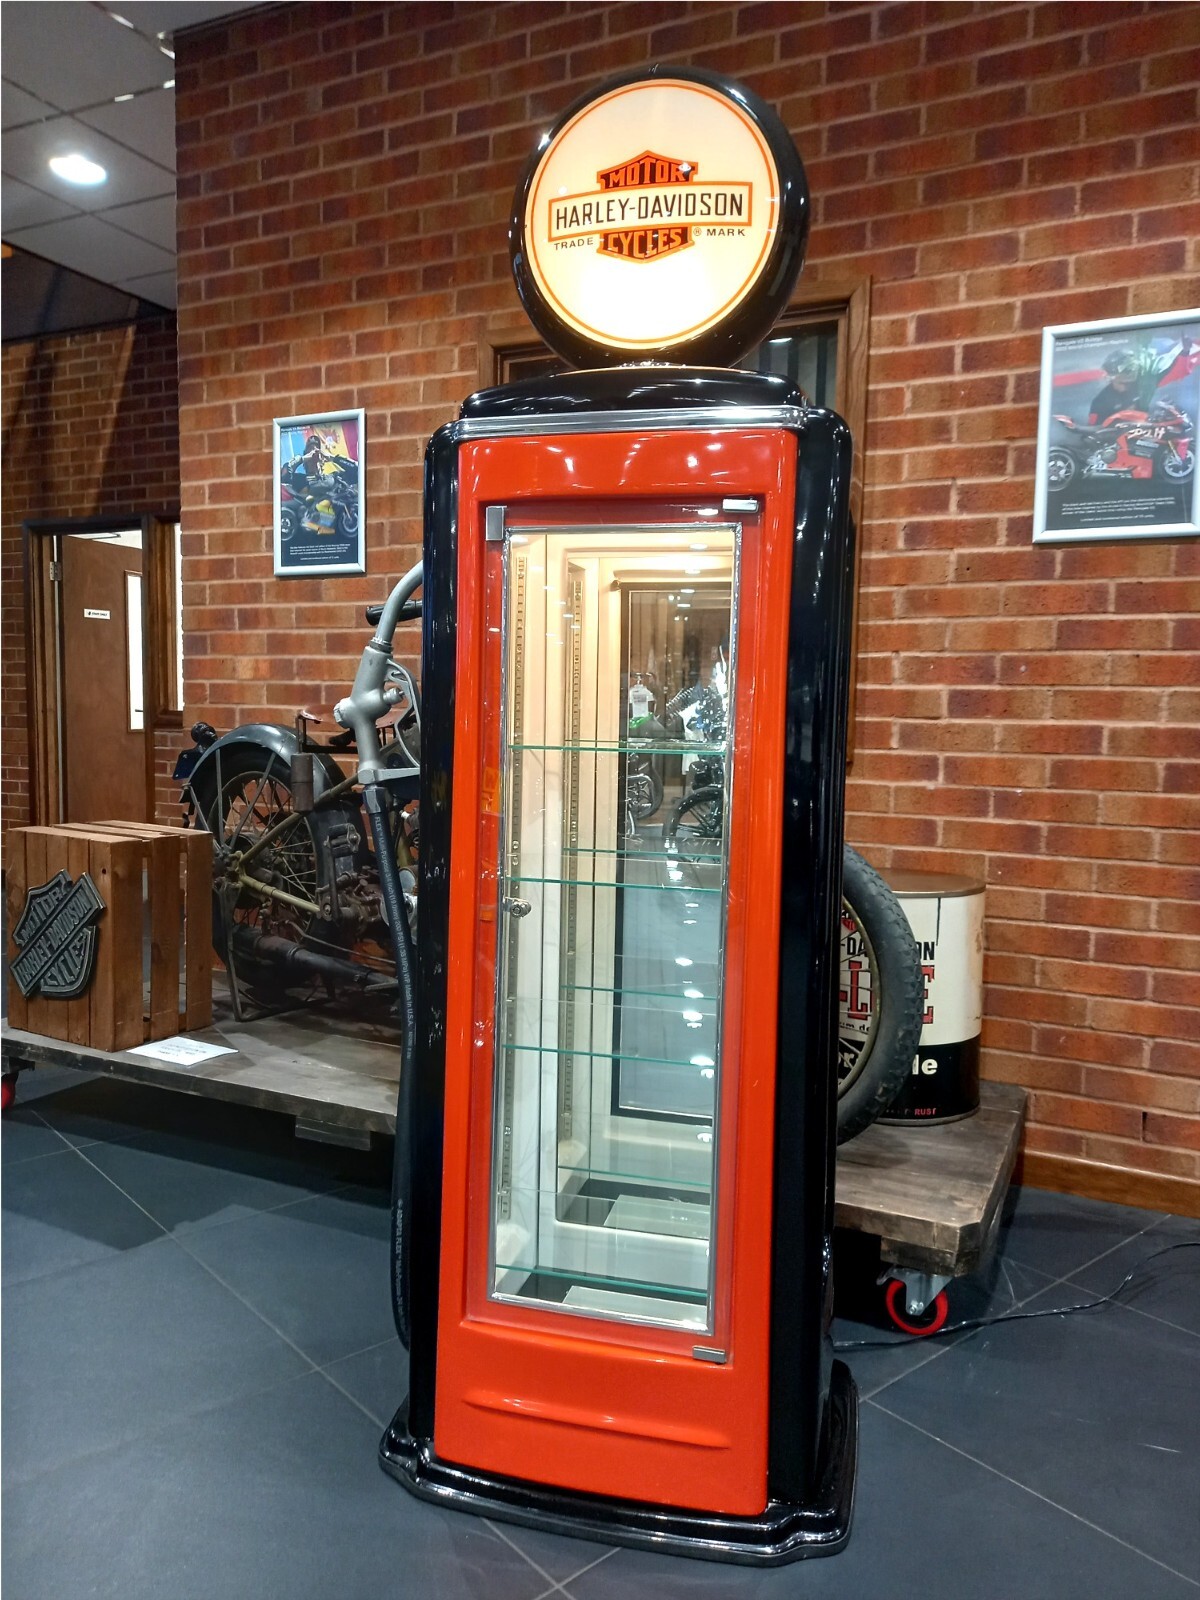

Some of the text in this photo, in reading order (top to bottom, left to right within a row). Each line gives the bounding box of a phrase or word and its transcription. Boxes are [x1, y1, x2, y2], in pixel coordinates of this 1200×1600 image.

[609, 157, 690, 187] MOTOR
[556, 193, 743, 230] HARLEY-DAVIDSON
[554, 237, 594, 251] TRADE
[706, 228, 746, 237] MARK
[607, 228, 682, 258] CYCLES
[405, 984, 413, 1000] Made
